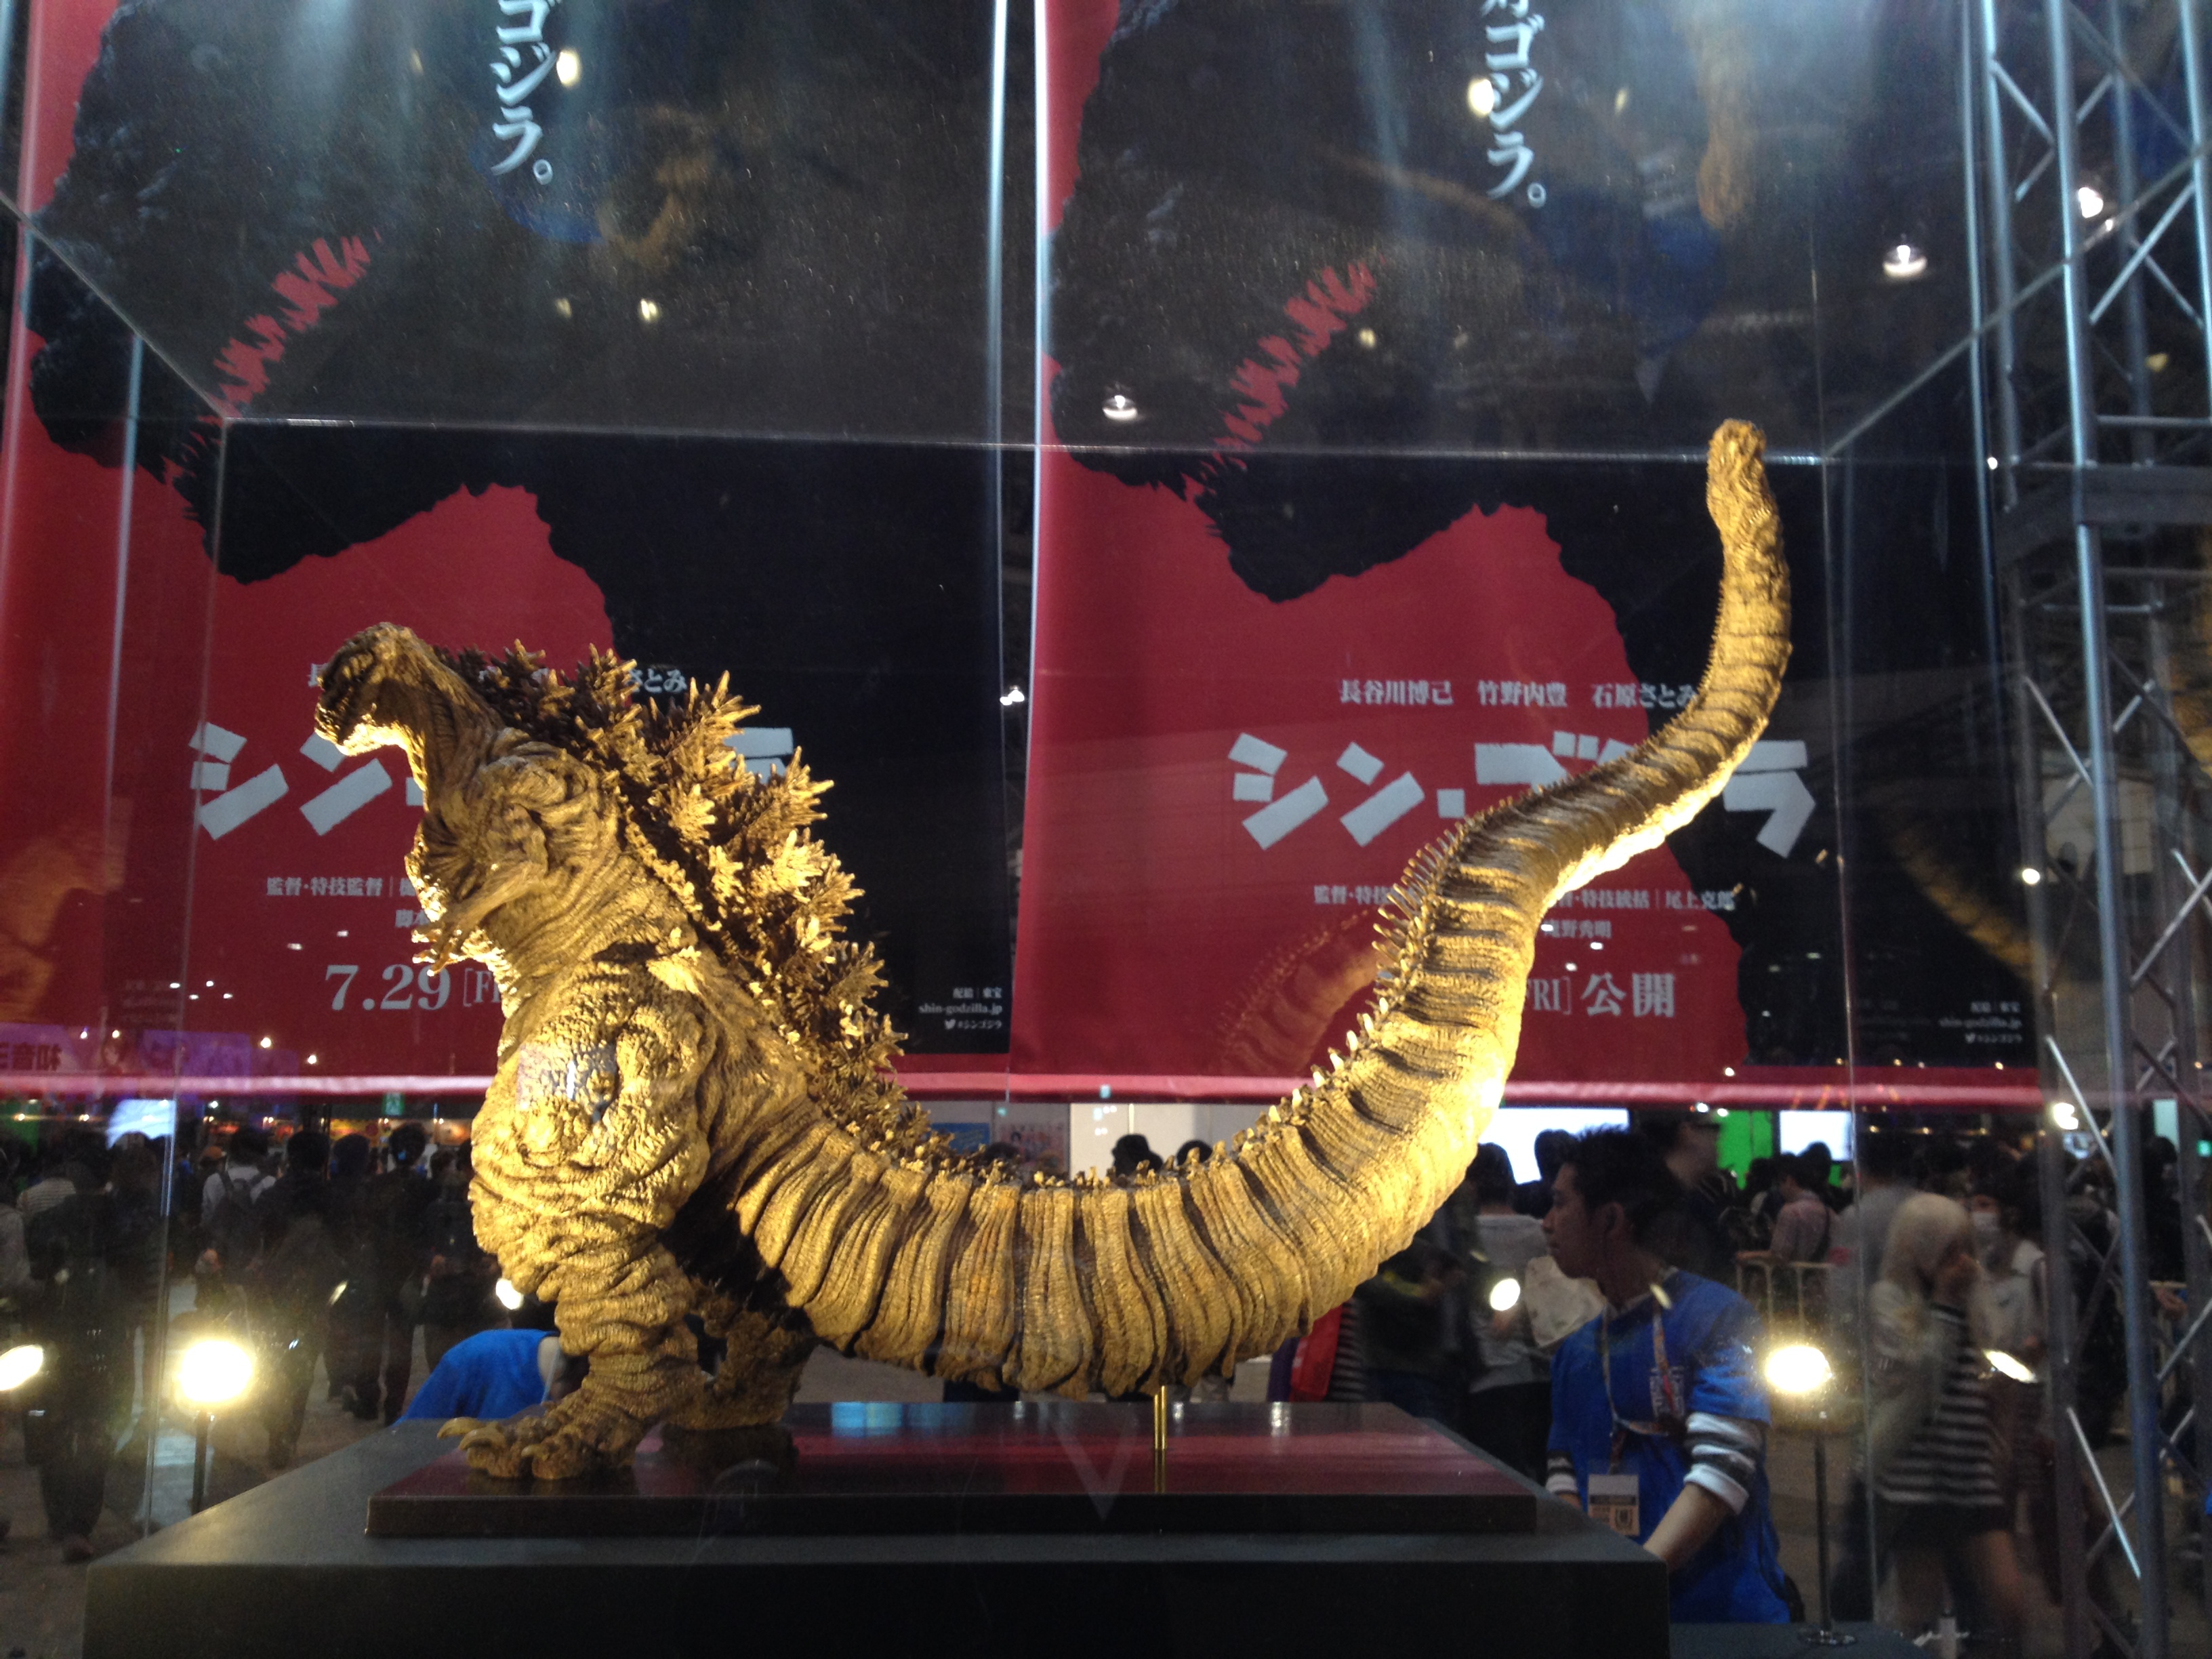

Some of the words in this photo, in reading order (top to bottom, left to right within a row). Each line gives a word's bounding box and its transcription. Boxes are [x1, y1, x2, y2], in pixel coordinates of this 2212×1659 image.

[1339, 679, 1454, 706] 長谷川博己
[1477, 680, 1567, 708] 竹野内豊
[1591, 680, 1696, 709] 石原さとみ
[325, 964, 451, 1011] 7.29
[1580, 972, 1675, 1018] 公開
